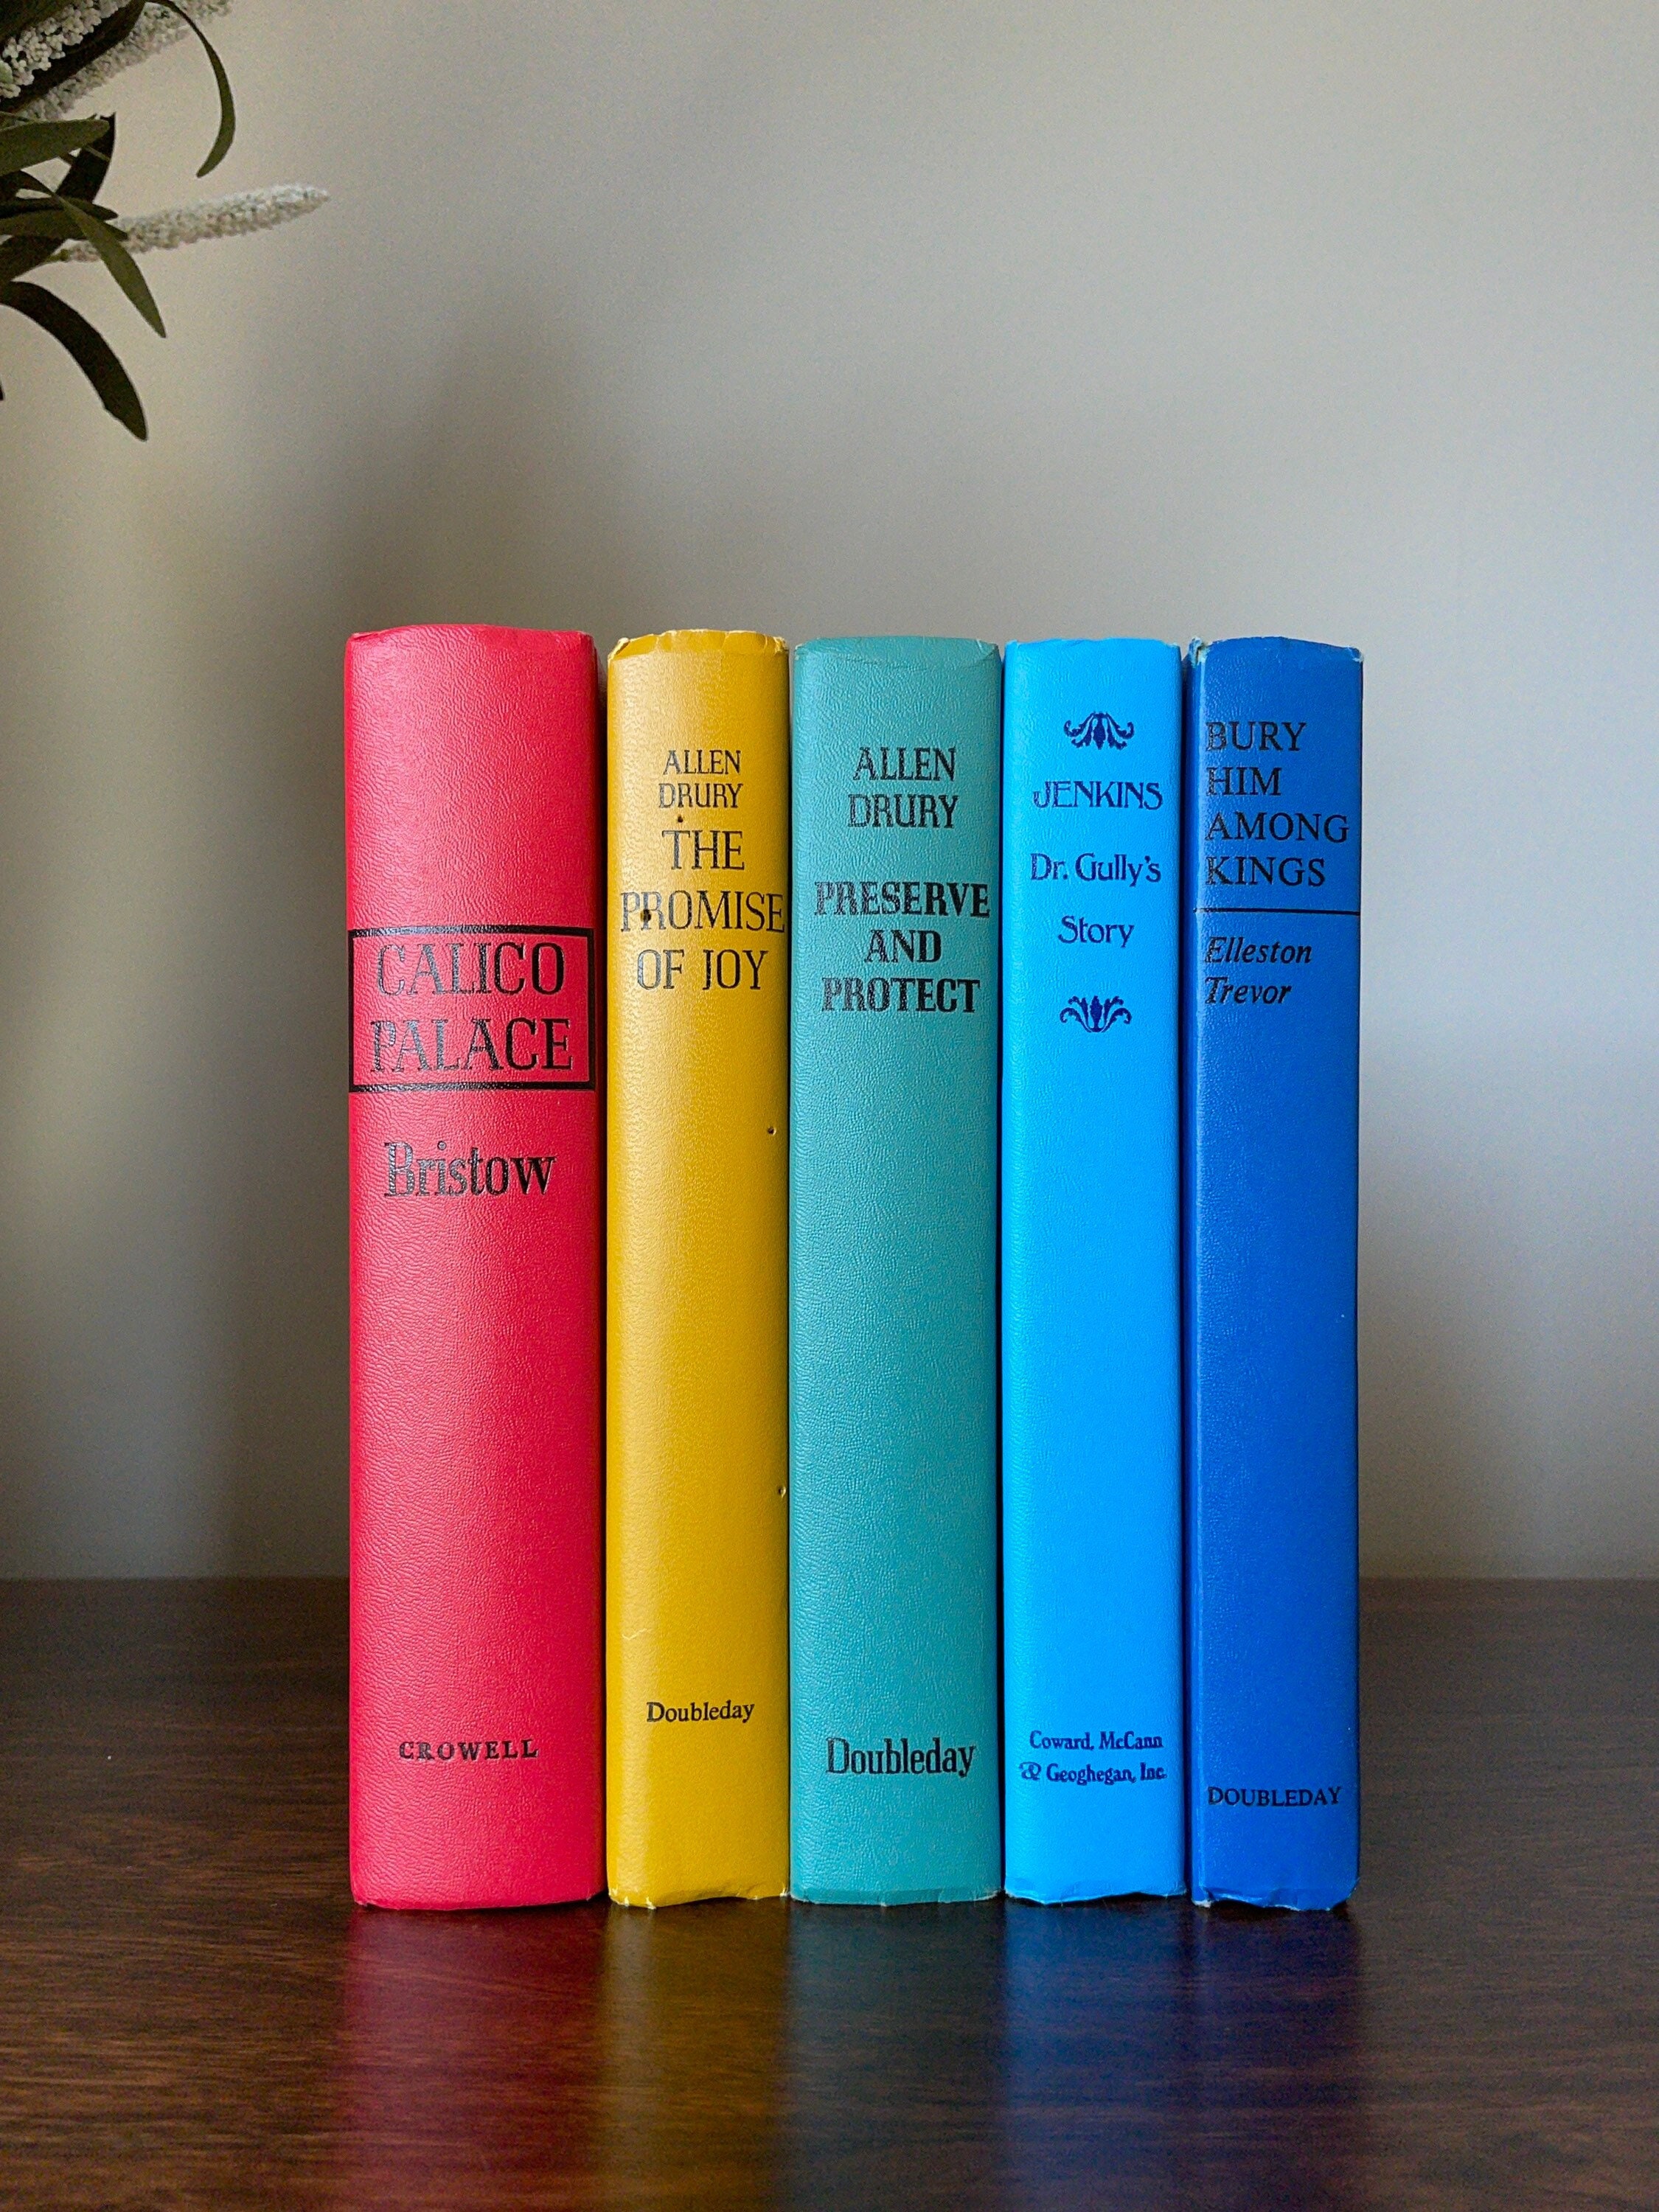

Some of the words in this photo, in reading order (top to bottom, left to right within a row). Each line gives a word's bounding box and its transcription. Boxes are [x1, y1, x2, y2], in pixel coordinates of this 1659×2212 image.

[1205, 722, 1307, 751] BURY
[663, 749, 741, 774] ALLEN
[853, 746, 956, 782] ALLEN
[658, 783, 744, 809] DRURY
[1033, 781, 1163, 810] JENKINS
[1206, 767, 1282, 797] HIM
[847, 793, 959, 829] DRURY
[1204, 812, 1349, 843] AMONG
[661, 830, 745, 871] THE
[1030, 852, 1068, 880] Dr.
[1075, 853, 1162, 887] Gully's
[1205, 856, 1326, 886] KINGS
[620, 890, 785, 933] PROMISE
[814, 881, 990, 919] PRESERVE
[864, 929, 942, 964] AND
[1057, 916, 1135, 947] Story
[1204, 936, 1312, 964] Elleston
[376, 942, 565, 995] CALICO
[637, 950, 684, 990] OF
[701, 949, 768, 990] JOY
[821, 976, 981, 1013] PROTECT
[1205, 976, 1292, 1005] Trevor
[369, 1018, 573, 1073] PALACE
[383, 1141, 555, 1197] Bristow
[646, 1700, 755, 1724] Doubleday
[399, 1738, 539, 1761] CROWELL
[1029, 1730, 1094, 1751] Coward,
[1099, 1731, 1164, 1749] McCann
[826, 1736, 977, 1778] Doubleday
[1046, 1763, 1135, 1785] Geoghegan,
[1140, 1762, 1166, 1781] Inc.
[1207, 1786, 1342, 1808] DOUBLEDAY
